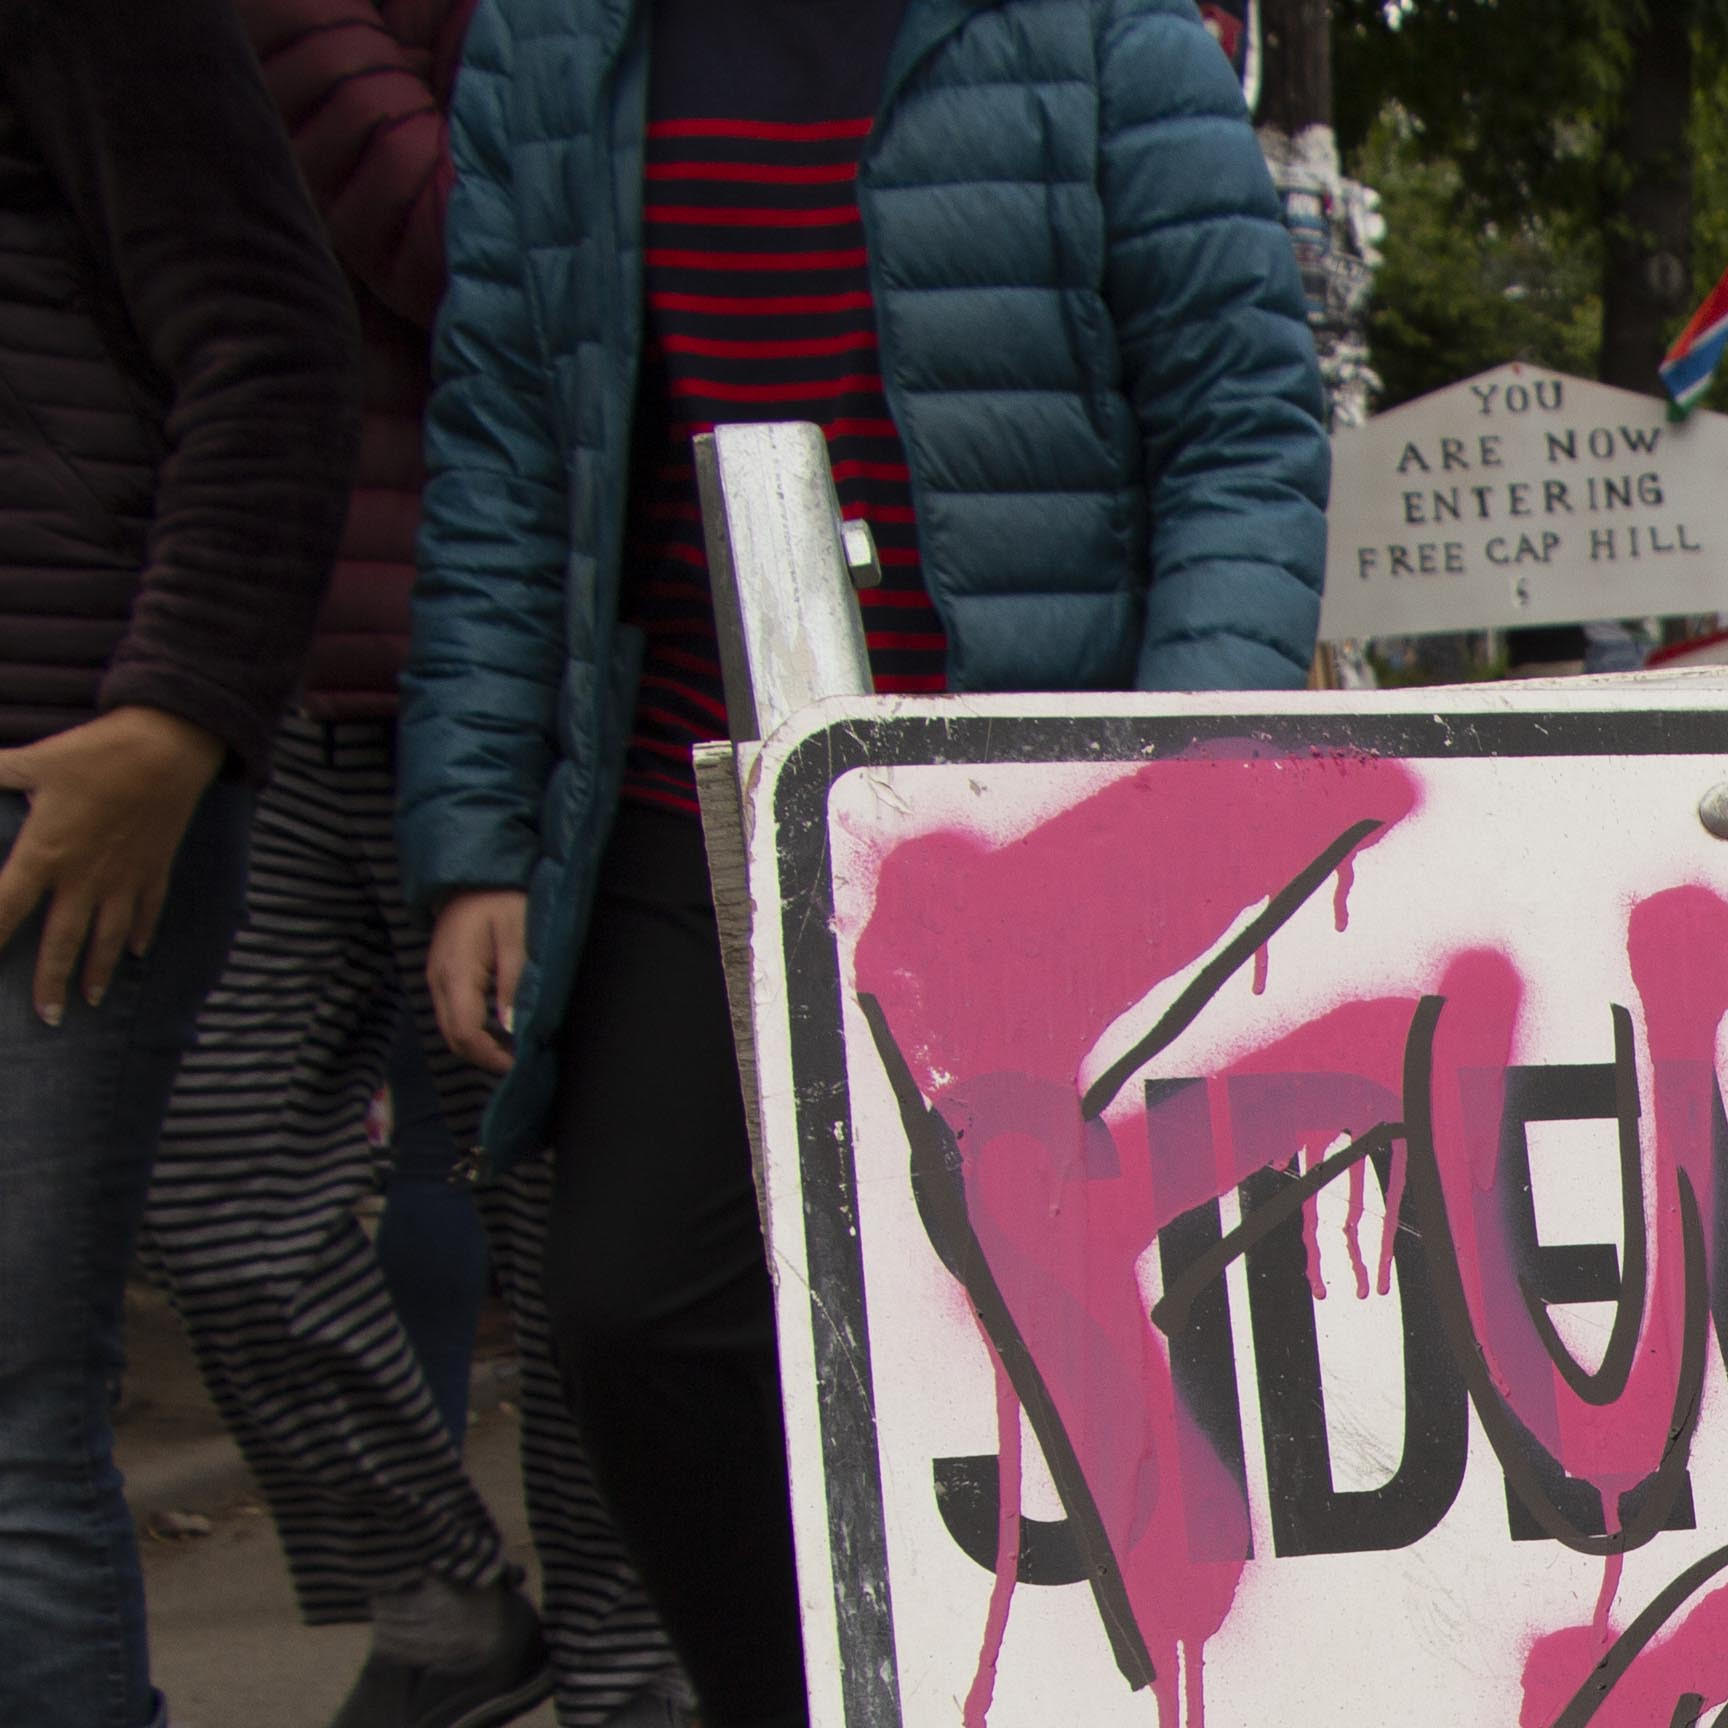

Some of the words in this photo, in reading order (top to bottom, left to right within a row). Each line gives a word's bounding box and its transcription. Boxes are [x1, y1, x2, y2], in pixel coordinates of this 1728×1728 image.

[1471, 380, 1564, 416] YOU
[1396, 435, 1503, 474] ARE
[1545, 426, 1662, 463] NOW
[1402, 472, 1666, 524] ENTERING
[1357, 542, 1467, 580] FREE
[1484, 530, 1562, 565] CAP
[1589, 524, 1702, 560] HILL
